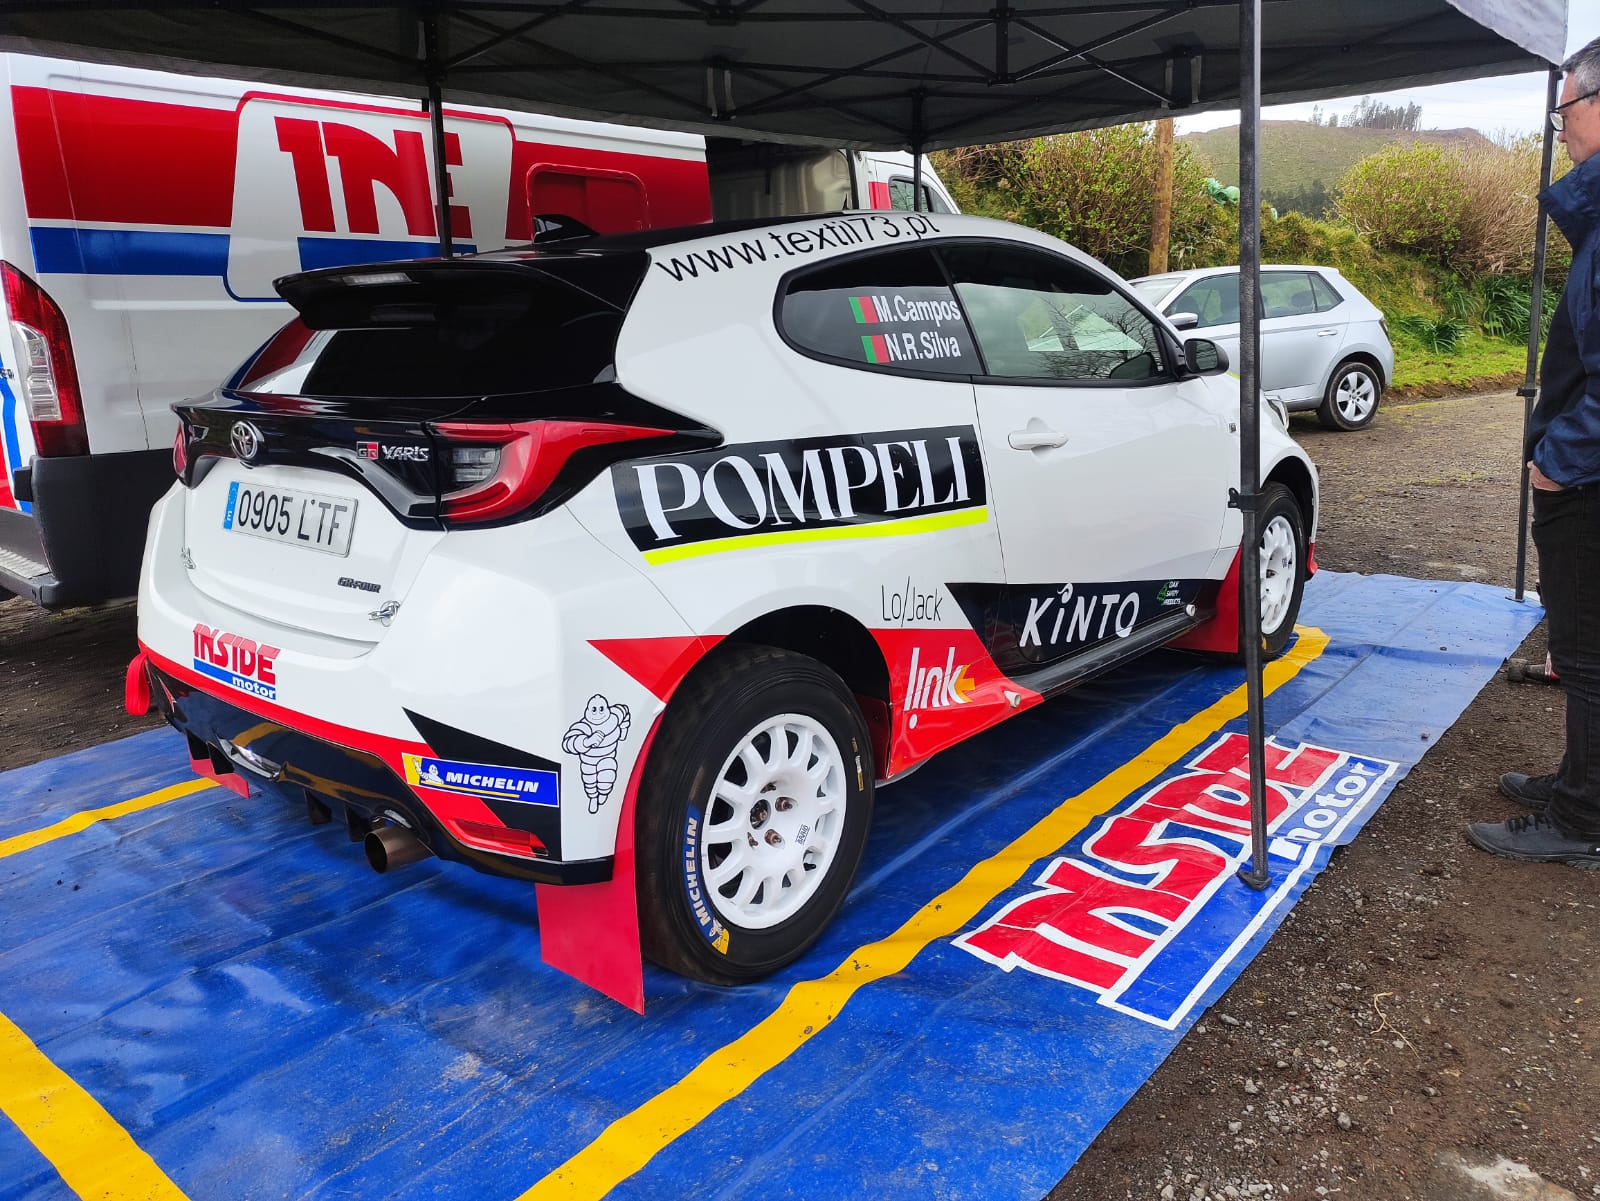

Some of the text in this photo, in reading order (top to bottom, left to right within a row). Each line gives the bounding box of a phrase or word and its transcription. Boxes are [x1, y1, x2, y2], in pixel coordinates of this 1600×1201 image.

[655, 212, 941, 282] www.textil73.pt
[872, 295, 961, 327] M.Campos
[884, 332, 961, 362] N.R.Silva
[382, 445, 429, 461] YARIS
[632, 436, 972, 541] POMPELI
[238, 490, 347, 546] 0905 LTF
[193, 623, 280, 685] INSIDE
[231, 674, 277, 699] motor
[446, 771, 540, 793] MICHELIN
[685, 816, 711, 927] MICHELIN
[960, 732, 1342, 991] INSIDE
